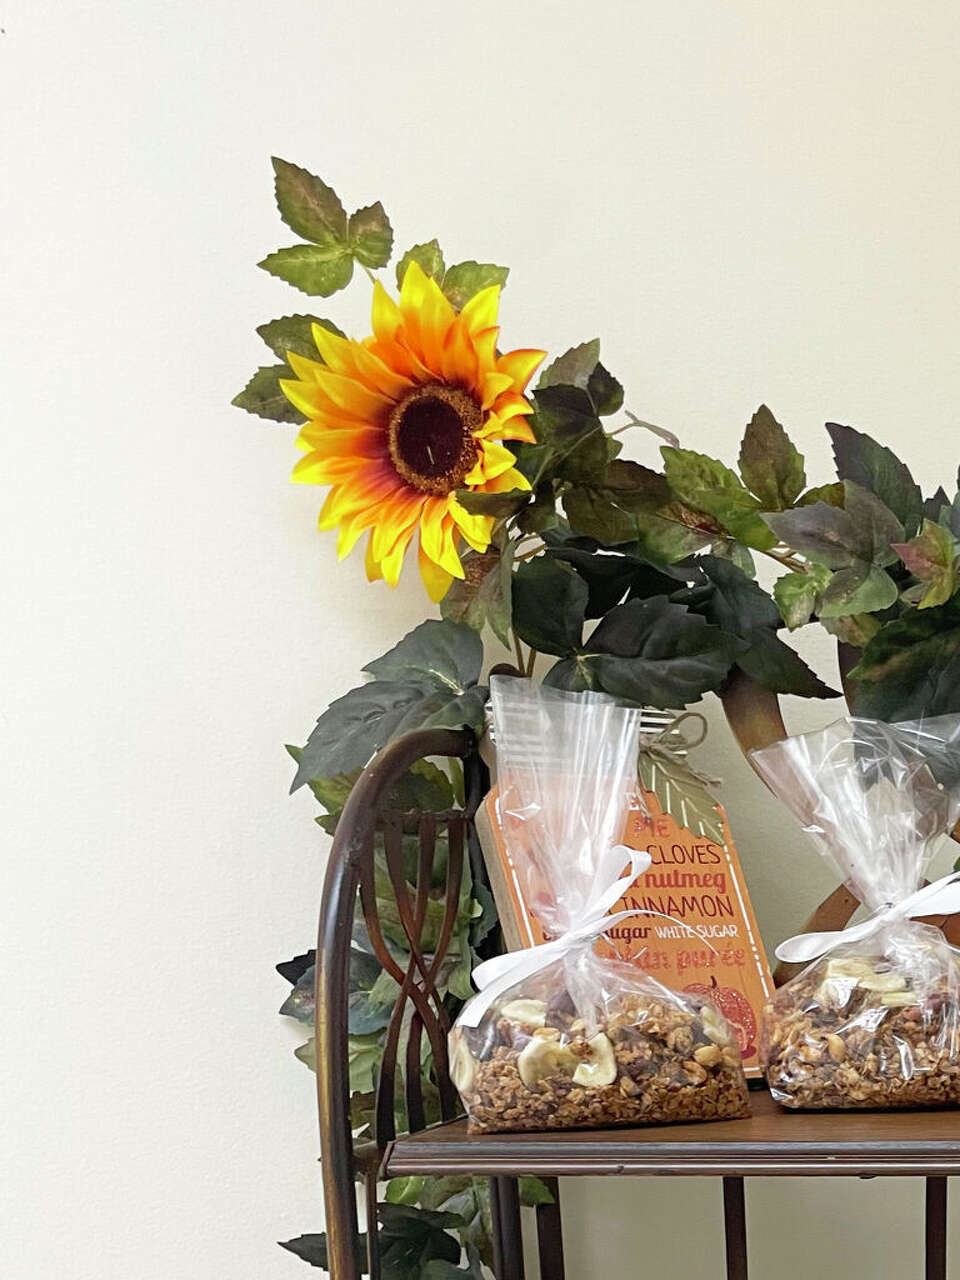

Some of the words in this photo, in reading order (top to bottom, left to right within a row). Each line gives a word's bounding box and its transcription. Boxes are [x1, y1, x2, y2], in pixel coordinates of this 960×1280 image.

[646, 844, 721, 865] CLOVES
[645, 869, 727, 894] nutmeg
[606, 894, 735, 919] INNAMON
[697, 924, 740, 939] SUGAR
